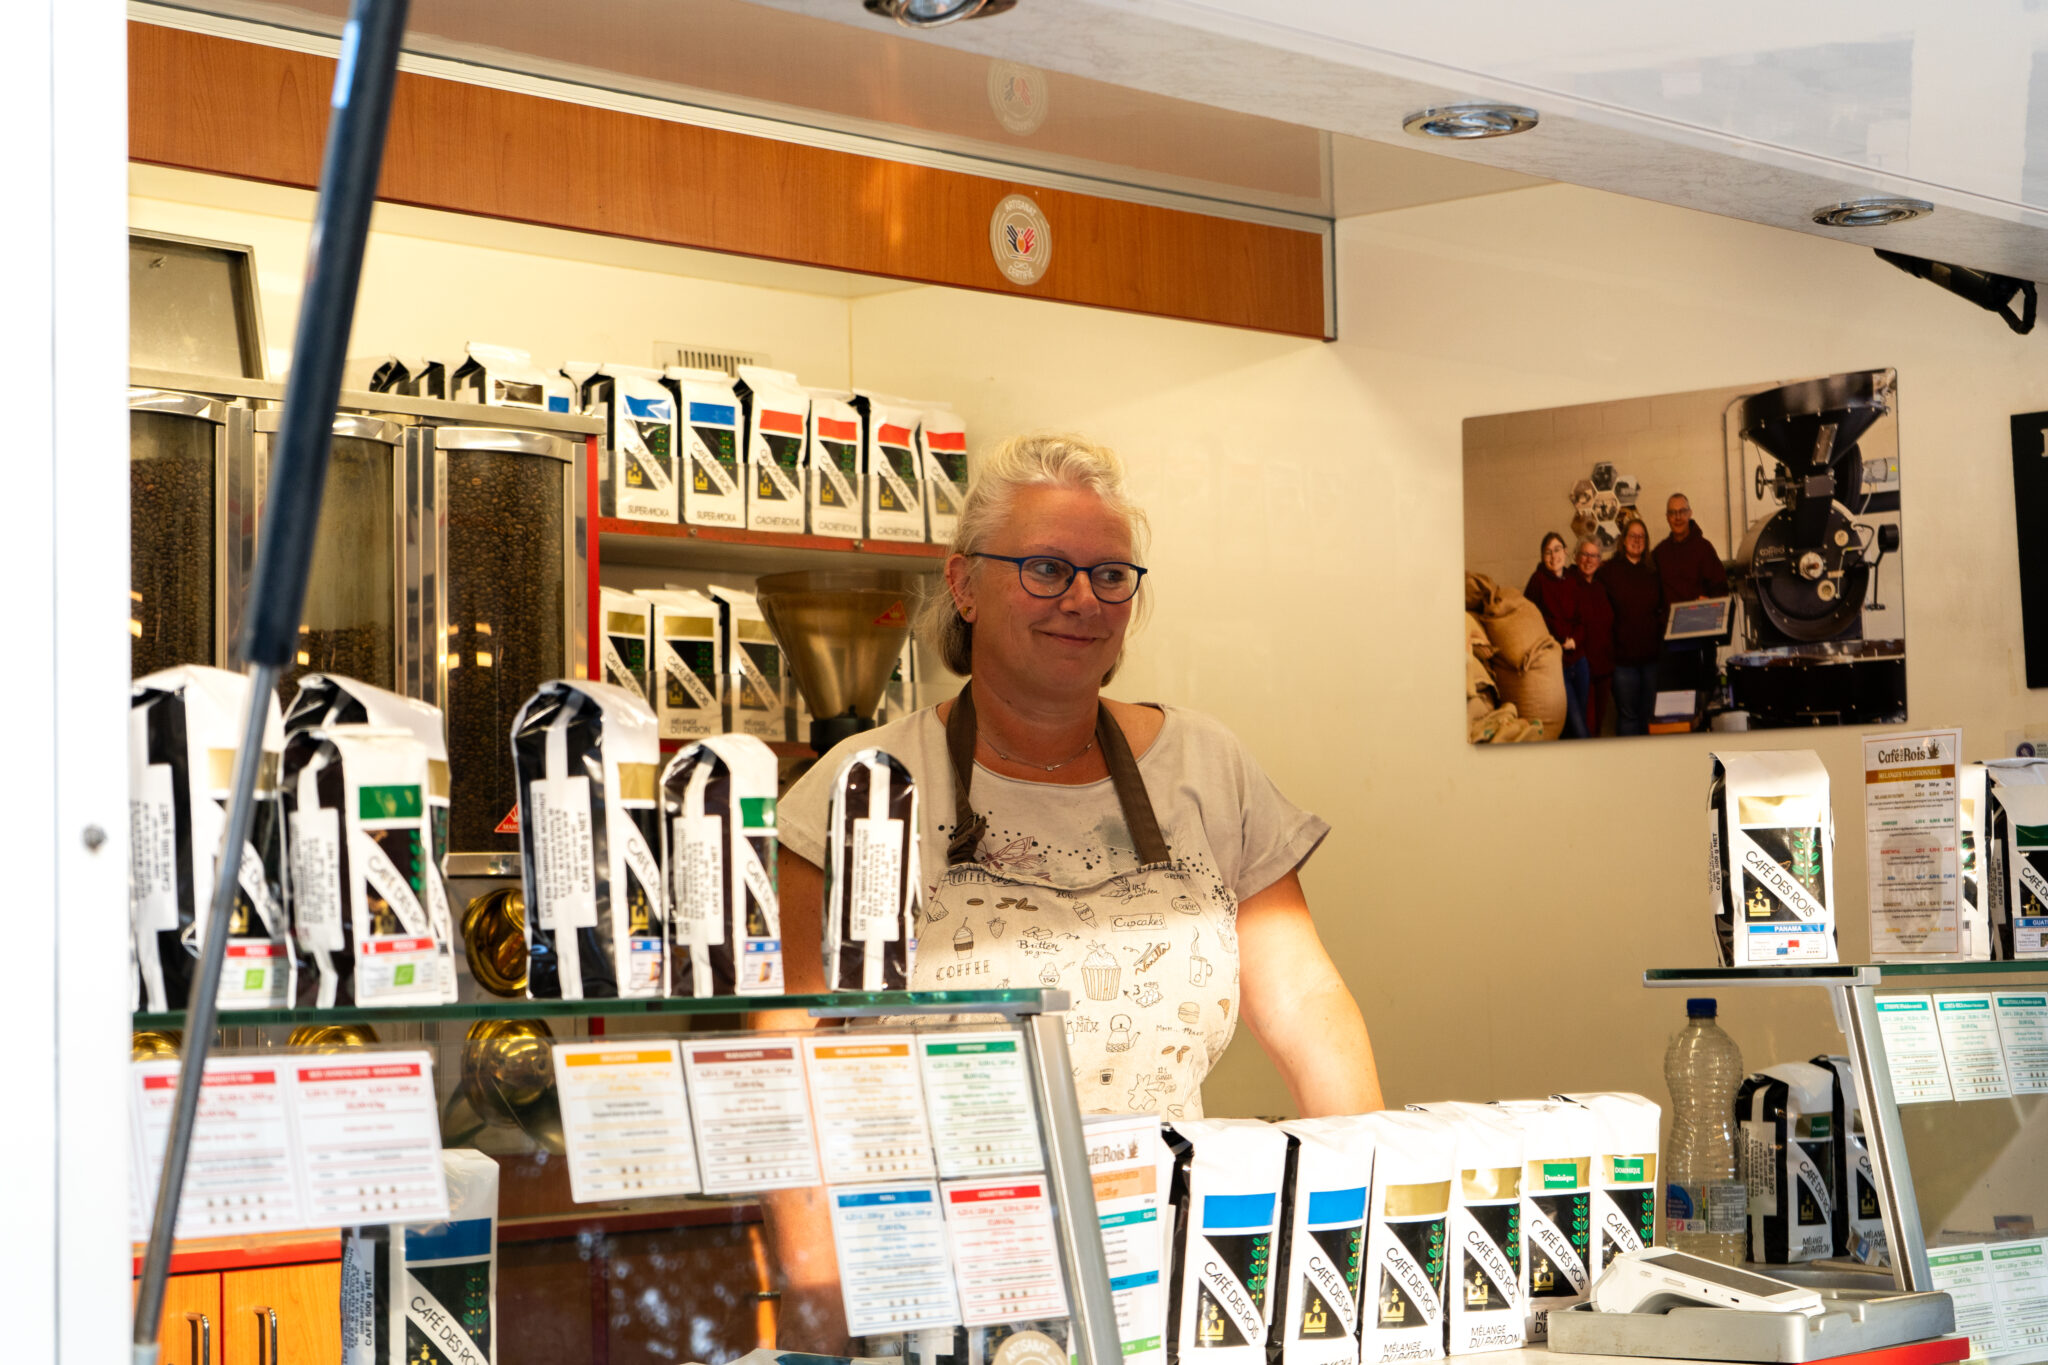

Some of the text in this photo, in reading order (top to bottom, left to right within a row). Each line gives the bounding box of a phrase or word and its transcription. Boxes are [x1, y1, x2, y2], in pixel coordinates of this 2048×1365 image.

[1005, 199, 1036, 216] ARTISANAT
[1878, 746, 1926, 764] Café Rois
[581, 864, 590, 893] CAFE
[1745, 851, 1816, 918] CAFÉ DES ROIS
[2022, 867, 2042, 891] CAFÉ
[1114, 916, 1164, 929] Cupcakes
[1017, 939, 1063, 952] Butter
[1135, 941, 1171, 976] Vanilla
[936, 959, 991, 982] COFFEE
[1133, 984, 1141, 996] 3
[1103, 1145, 1126, 1163] Rois
[1544, 1174, 1575, 1183] Dominique
[1614, 1166, 1641, 1175] DOMINIQUE
[1800, 1161, 1819, 1186] CAFÉ
[1606, 1213, 1633, 1244] CAFÉ
[1467, 1231, 1508, 1281] CAFÉ DES
[1532, 1219, 1586, 1291] CAFÉ DES ROIS
[364, 1270, 372, 1290] NET
[1309, 1256, 1336, 1287] CAFÉ
[1328, 1281, 1346, 1311] DES
[1386, 1247, 1437, 1320] CAFÉ DES ROIS
[1204, 1261, 1260, 1340] CAFÉ DES ROIS
[411, 1296, 478, 1365] CAFÉ DES RO
[1469, 1333, 1521, 1349] DU PATRON
[1471, 1324, 1506, 1337] MÉLANGE
[1004, 1338, 1051, 1364] ARTISANAT
[1379, 1348, 1437, 1364] DU PATRON
[1384, 1340, 1422, 1352] MÉLANGE
